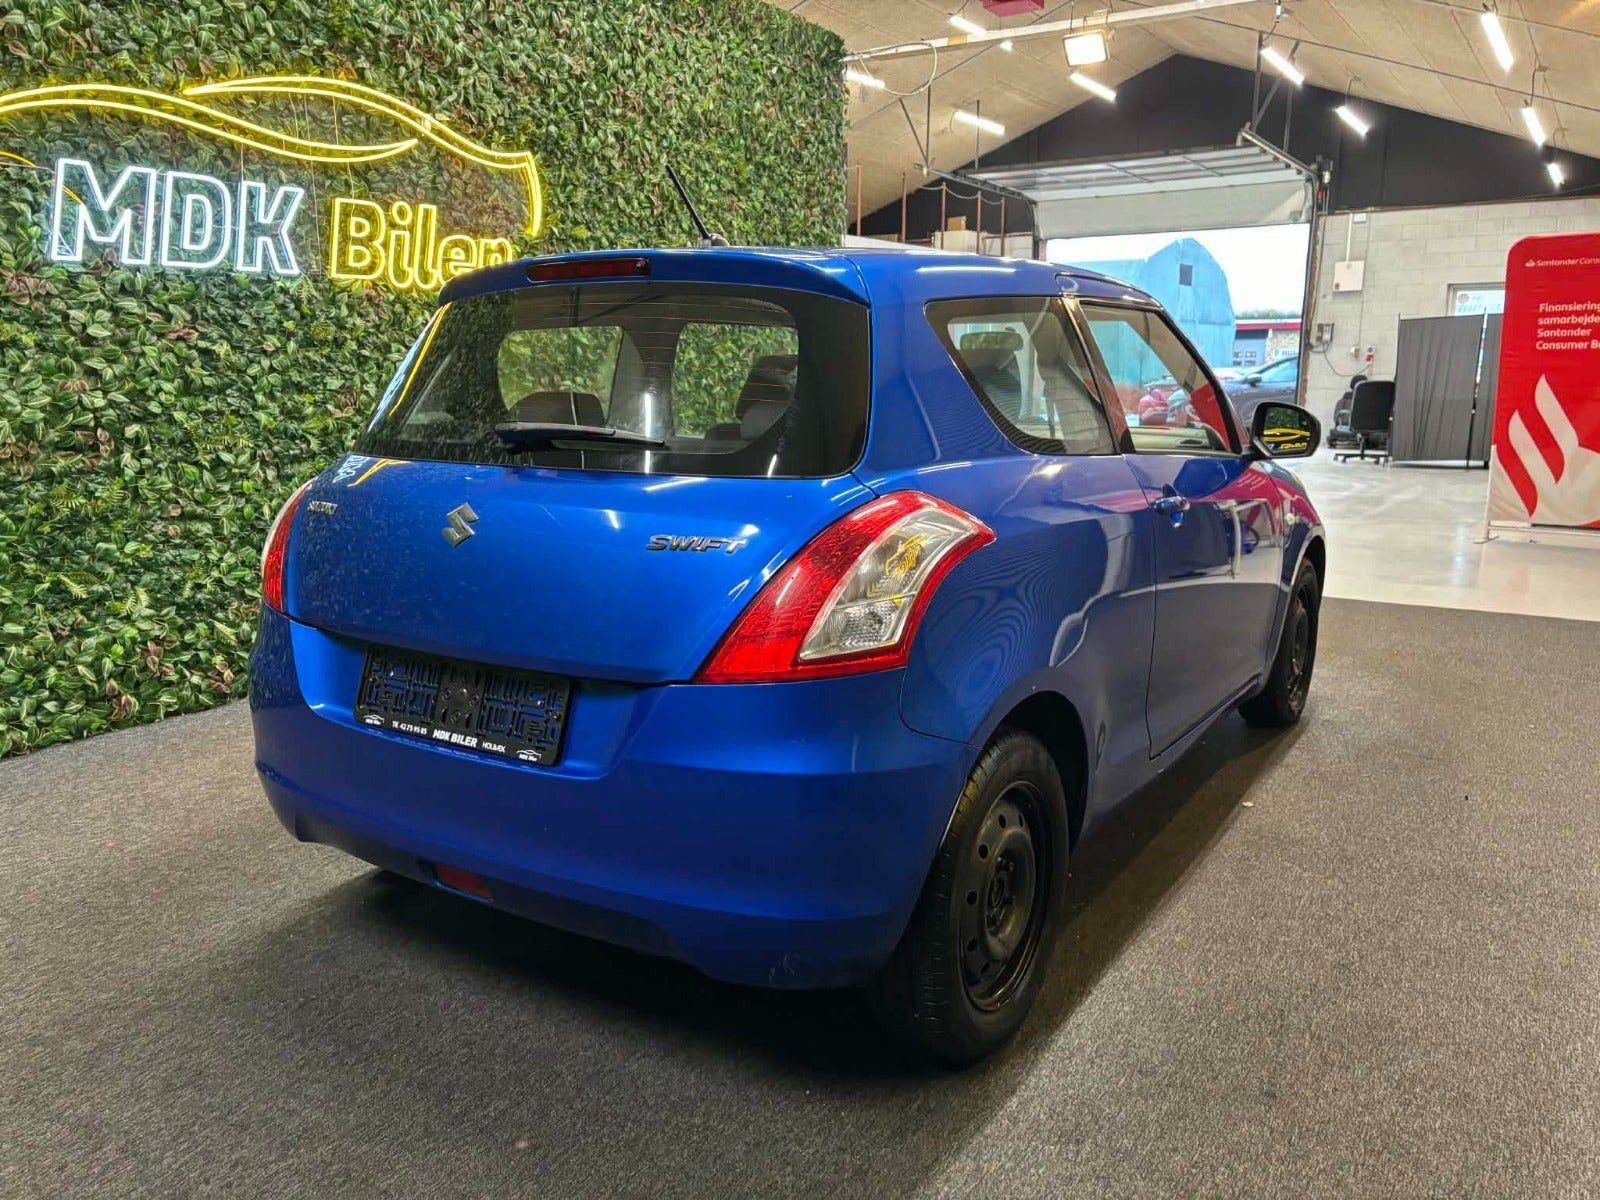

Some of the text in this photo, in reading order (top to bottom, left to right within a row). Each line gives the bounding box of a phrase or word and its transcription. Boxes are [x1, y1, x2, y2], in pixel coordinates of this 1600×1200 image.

[49, 158, 304, 274] MDK
[1537, 258, 1579, 267] Santander
[1537, 327, 1592, 338] Santander
[1535, 339, 1600, 350] Consumer B
[646, 534, 748, 554] SWIFT
[432, 728, 451, 741] MDK
[451, 732, 478, 748] BILER
